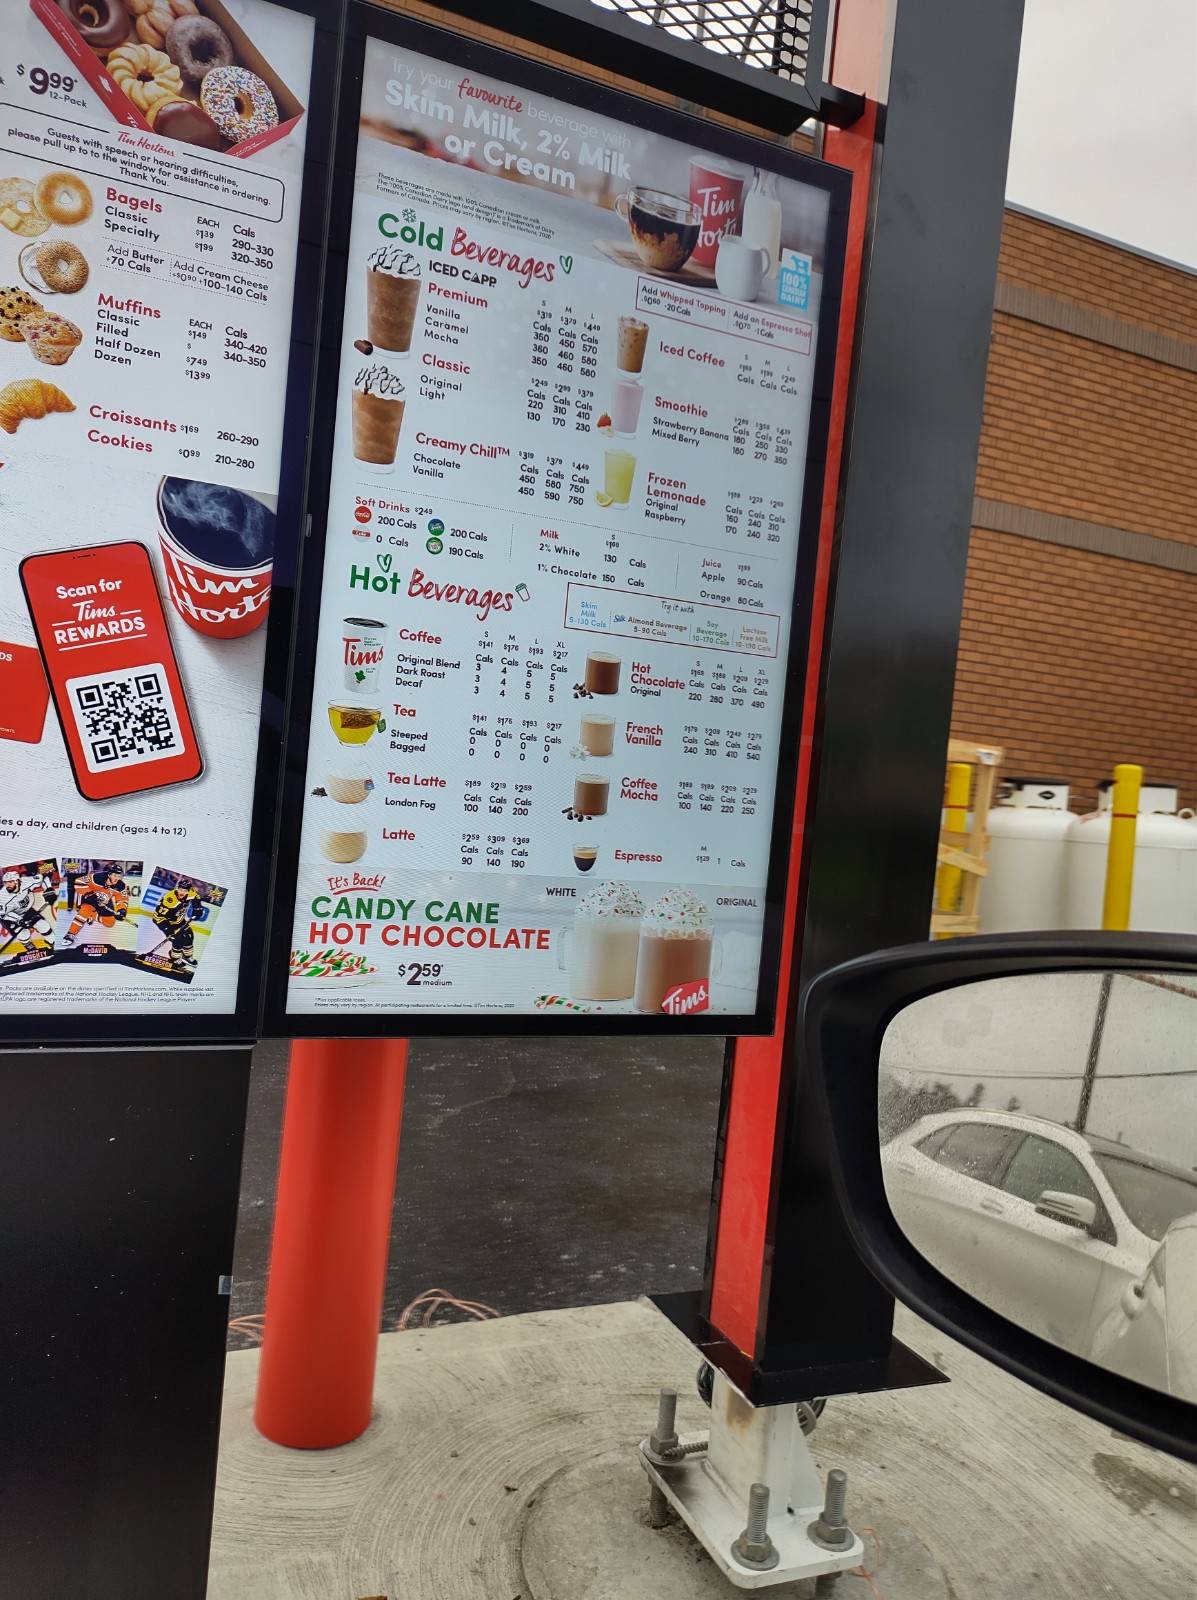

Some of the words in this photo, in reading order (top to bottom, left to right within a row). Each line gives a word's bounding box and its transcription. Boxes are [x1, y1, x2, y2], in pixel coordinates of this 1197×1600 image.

[49, 91, 87, 108] 12-Pack
[391, 56, 416, 80] Try
[420, 73, 456, 91] your
[457, 78, 524, 112] favourite
[528, 105, 598, 138] beverage
[604, 128, 632, 149] with
[385, 79, 454, 122] Skim
[463, 106, 528, 150] Milk,
[536, 130, 570, 160] 2%
[579, 142, 632, 180] Milk
[117, 130, 136, 146] Tim
[137, 136, 176, 157] Hortons
[8, 128, 41, 144] please
[43, 136, 61, 148] pull
[64, 142, 76, 154] up
[78, 144, 88, 153] to
[90, 147, 101, 157] to
[102, 150, 118, 163] the
[120, 157, 156, 173] window
[158, 166, 171, 177] for
[174, 173, 220, 193] assistance
[222, 185, 229, 193] in
[232, 189, 271, 205] ordering.
[47, 128, 81, 143] Guests
[82, 135, 103, 149] with
[105, 141, 138, 159] speech
[141, 151, 151, 160] or
[153, 153, 188, 174] hearing
[190, 164, 238, 188] difficulties,
[444, 134, 475, 159] or
[483, 141, 576, 190] Cream
[119, 166, 148, 180] Thank
[151, 175, 169, 188] You.
[106, 187, 163, 213] Bagels
[697, 187, 735, 217] Tim
[105, 206, 148, 224] Classic
[104, 219, 160, 242] Specialty
[197, 217, 220, 229] EACH
[233, 224, 255, 238] Cals
[107, 244, 128, 257] Add
[132, 250, 164, 266] Butter
[378, 212, 443, 251] Cold
[450, 227, 555, 288] Beverages
[173, 260, 195, 272] Add
[197, 266, 230, 283] Cream
[233, 275, 269, 291] Cheese
[429, 260, 458, 277] ICED
[428, 282, 488, 307] Premium
[642, 285, 657, 295] Add
[660, 289, 694, 305] Whipped
[696, 300, 726, 316] Topping
[97, 293, 161, 319] Muffins
[426, 304, 461, 320] Vanilla
[97, 309, 140, 327] Classic
[425, 317, 469, 334] Caramel
[96, 322, 129, 338] Filled
[424, 329, 459, 345] Mocha
[95, 336, 121, 351] Half
[124, 342, 161, 359] Dozen
[660, 341, 684, 357] Iced
[688, 349, 725, 367] Coffee
[94, 350, 132, 366] Dozen
[422, 353, 471, 374] Classic
[420, 375, 462, 391] Original
[419, 387, 445, 400] Light
[655, 396, 708, 418] Smoothie
[89, 405, 177, 433] Croissants
[653, 417, 698, 435] Strawberry
[700, 427, 729, 440] Banana
[87, 429, 153, 452] Cookies
[416, 433, 466, 454] Creamy
[652, 429, 678, 441] Mixed
[678, 434, 700, 447] Berry
[413, 453, 461, 469] Chocolate
[648, 472, 687, 490] Frozen
[647, 485, 706, 506] Lemonade
[355, 496, 376, 508] Soft
[379, 500, 410, 514] Drinks
[646, 499, 678, 511] Original
[378, 516, 395, 526] 200
[397, 518, 417, 530] Cals
[645, 510, 686, 526] Raspberry
[540, 529, 559, 540] Milk
[539, 543, 552, 553] 2%
[554, 545, 580, 558] White
[701, 558, 722, 569] Juice
[551, 566, 597, 580] Chocolate
[701, 571, 725, 583] Apple
[56, 584, 96, 599] Scan
[99, 578, 122, 592] for
[350, 565, 400, 594] Hot
[407, 568, 513, 621] Beverages
[700, 591, 731, 603] Orange
[72, 600, 117, 622] Tims
[54, 617, 146, 644] REWARDS
[399, 629, 442, 644] Coffee
[342, 637, 384, 666] Tims
[398, 654, 434, 667] Original
[436, 658, 460, 669] Blend
[632, 662, 651, 674] Hot
[397, 666, 419, 677] Dark
[420, 668, 446, 679] Roast
[396, 678, 423, 688] Decaf
[631, 674, 685, 690] Chocolate
[630, 686, 661, 697] Original
[393, 704, 416, 717] Tea
[391, 730, 428, 742] Steeped
[627, 722, 663, 736] French
[390, 741, 425, 753] Bagged
[626, 734, 662, 747] Vanilla
[387, 772, 410, 785] Tea
[413, 775, 447, 788] Latte
[622, 777, 658, 790] Coffee
[385, 797, 418, 808] London
[420, 799, 436, 810] Fog
[620, 789, 658, 801] Mocha
[464, 803, 478, 812] 100
[489, 806, 503, 814] 140
[513, 807, 528, 816] 200
[27, 818, 49, 829] day,
[52, 820, 72, 829] and
[76, 821, 118, 832] children
[120, 824, 149, 835] (ages
[161, 826, 170, 835] to
[173, 826, 187, 837] 12)
[383, 828, 416, 841] Latte
[615, 850, 662, 863] Espresso
[327, 874, 350, 891] It's
[352, 873, 386, 889] Back!
[546, 887, 576, 898] WHITE
[310, 896, 416, 922] CANDY
[425, 900, 500, 924] CANE
[716, 897, 757, 908] ORIGINAL
[310, 922, 372, 946] HOT
[381, 925, 550, 951] CHOCOLATE
[423, 978, 453, 987] medium
[663, 988, 708, 1015] Tims
